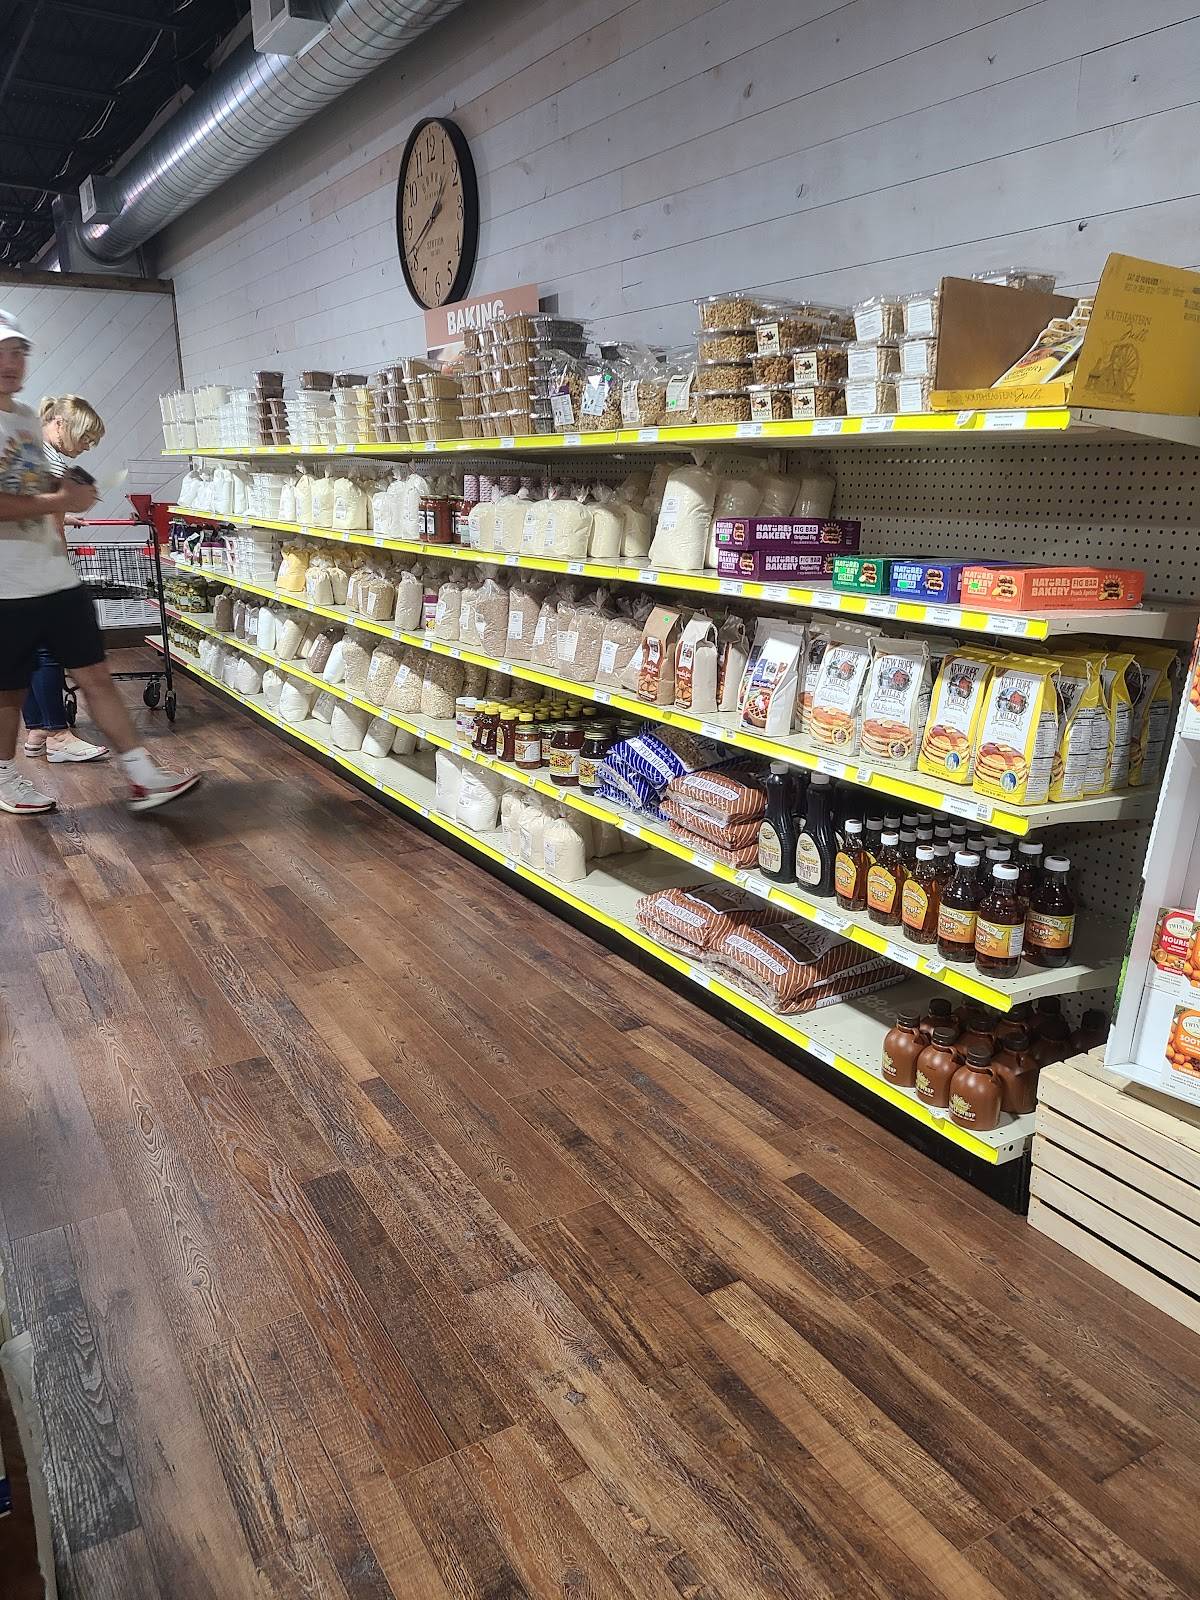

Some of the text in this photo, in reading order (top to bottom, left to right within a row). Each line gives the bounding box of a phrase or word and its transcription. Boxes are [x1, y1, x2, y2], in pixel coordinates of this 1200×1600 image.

[426, 134, 436, 164] 12
[441, 138, 446, 165] 1
[415, 151, 423, 178] 11
[451, 160, 458, 187] 2
[409, 180, 418, 207] 10
[457, 194, 463, 220] 3
[407, 215, 413, 241] 9
[454, 230, 461, 257] 4
[413, 246, 419, 272] 8
[423, 266, 428, 292] 7
[435, 271, 440, 297] 6
[447, 260, 453, 286] 5
[447, 299, 505, 336] BAKING
[756, 532, 792, 540] BAKERY
[794, 525, 818, 534] FIG BAR
[765, 562, 798, 571] BAKERY
[893, 572, 923, 581] BAKERY
[1032, 587, 1070, 597] BAKERY
[1072, 578, 1098, 588] FIG BAR
[881, 657, 897, 669] NEW
[880, 688, 902, 699] MILLS
[999, 676, 1034, 696] NEW HOPE
[998, 711, 1018, 722] MILLS
[740, 941, 759, 957] BRAN
[759, 951, 785, 974] FLAKES
